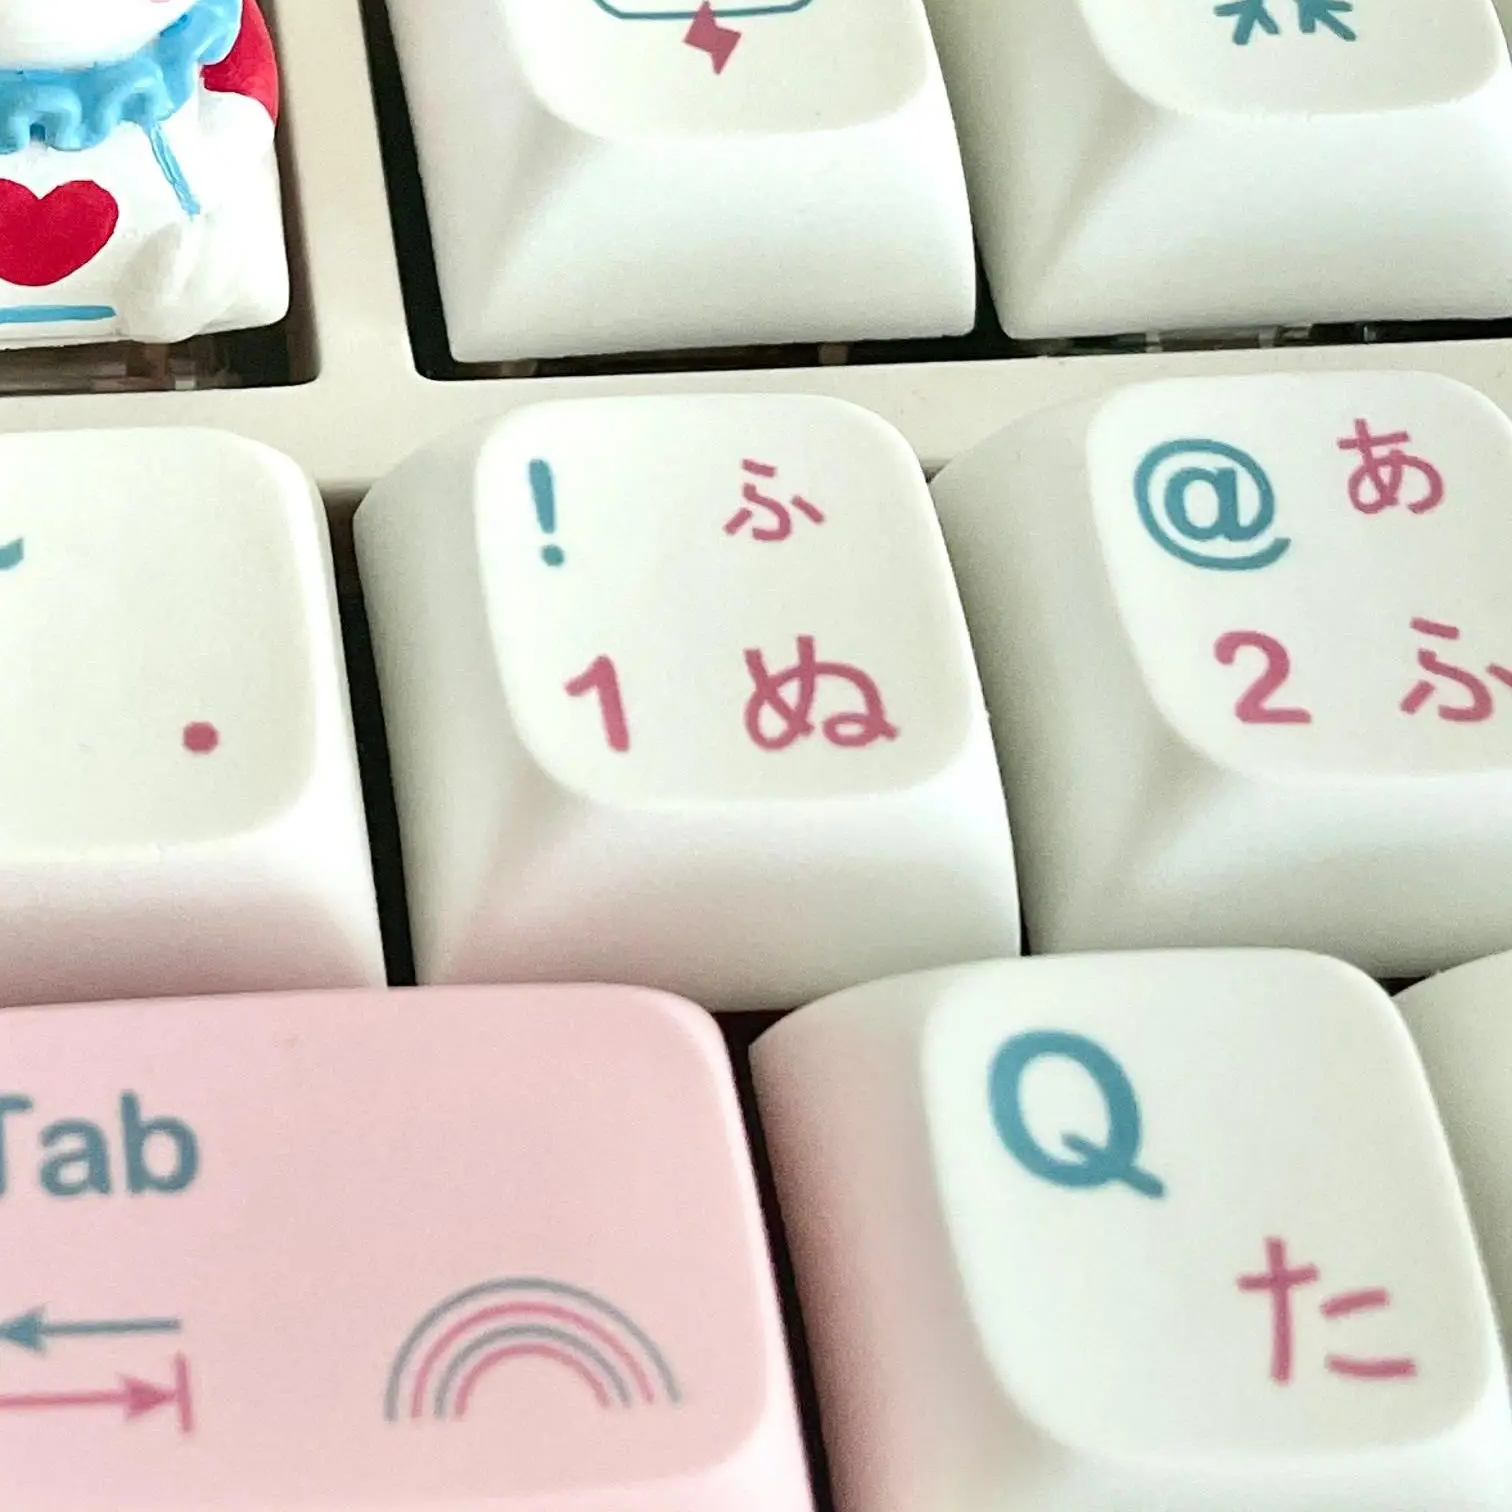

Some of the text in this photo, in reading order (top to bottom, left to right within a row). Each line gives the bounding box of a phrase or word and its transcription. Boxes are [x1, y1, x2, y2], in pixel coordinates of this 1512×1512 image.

[528, 457, 565, 567] !
[723, 458, 826, 542] ふ
[1133, 437, 1291, 571] @
[1336, 418, 1445, 515] あ
[564, 654, 630, 753] 1
[742, 634, 898, 752] ぬ
[1214, 629, 1313, 724] 2
[1399, 616, 1512, 724] ふ
[989, 1029, 1167, 1199] Q
[1236, 1235, 1418, 1387] た
